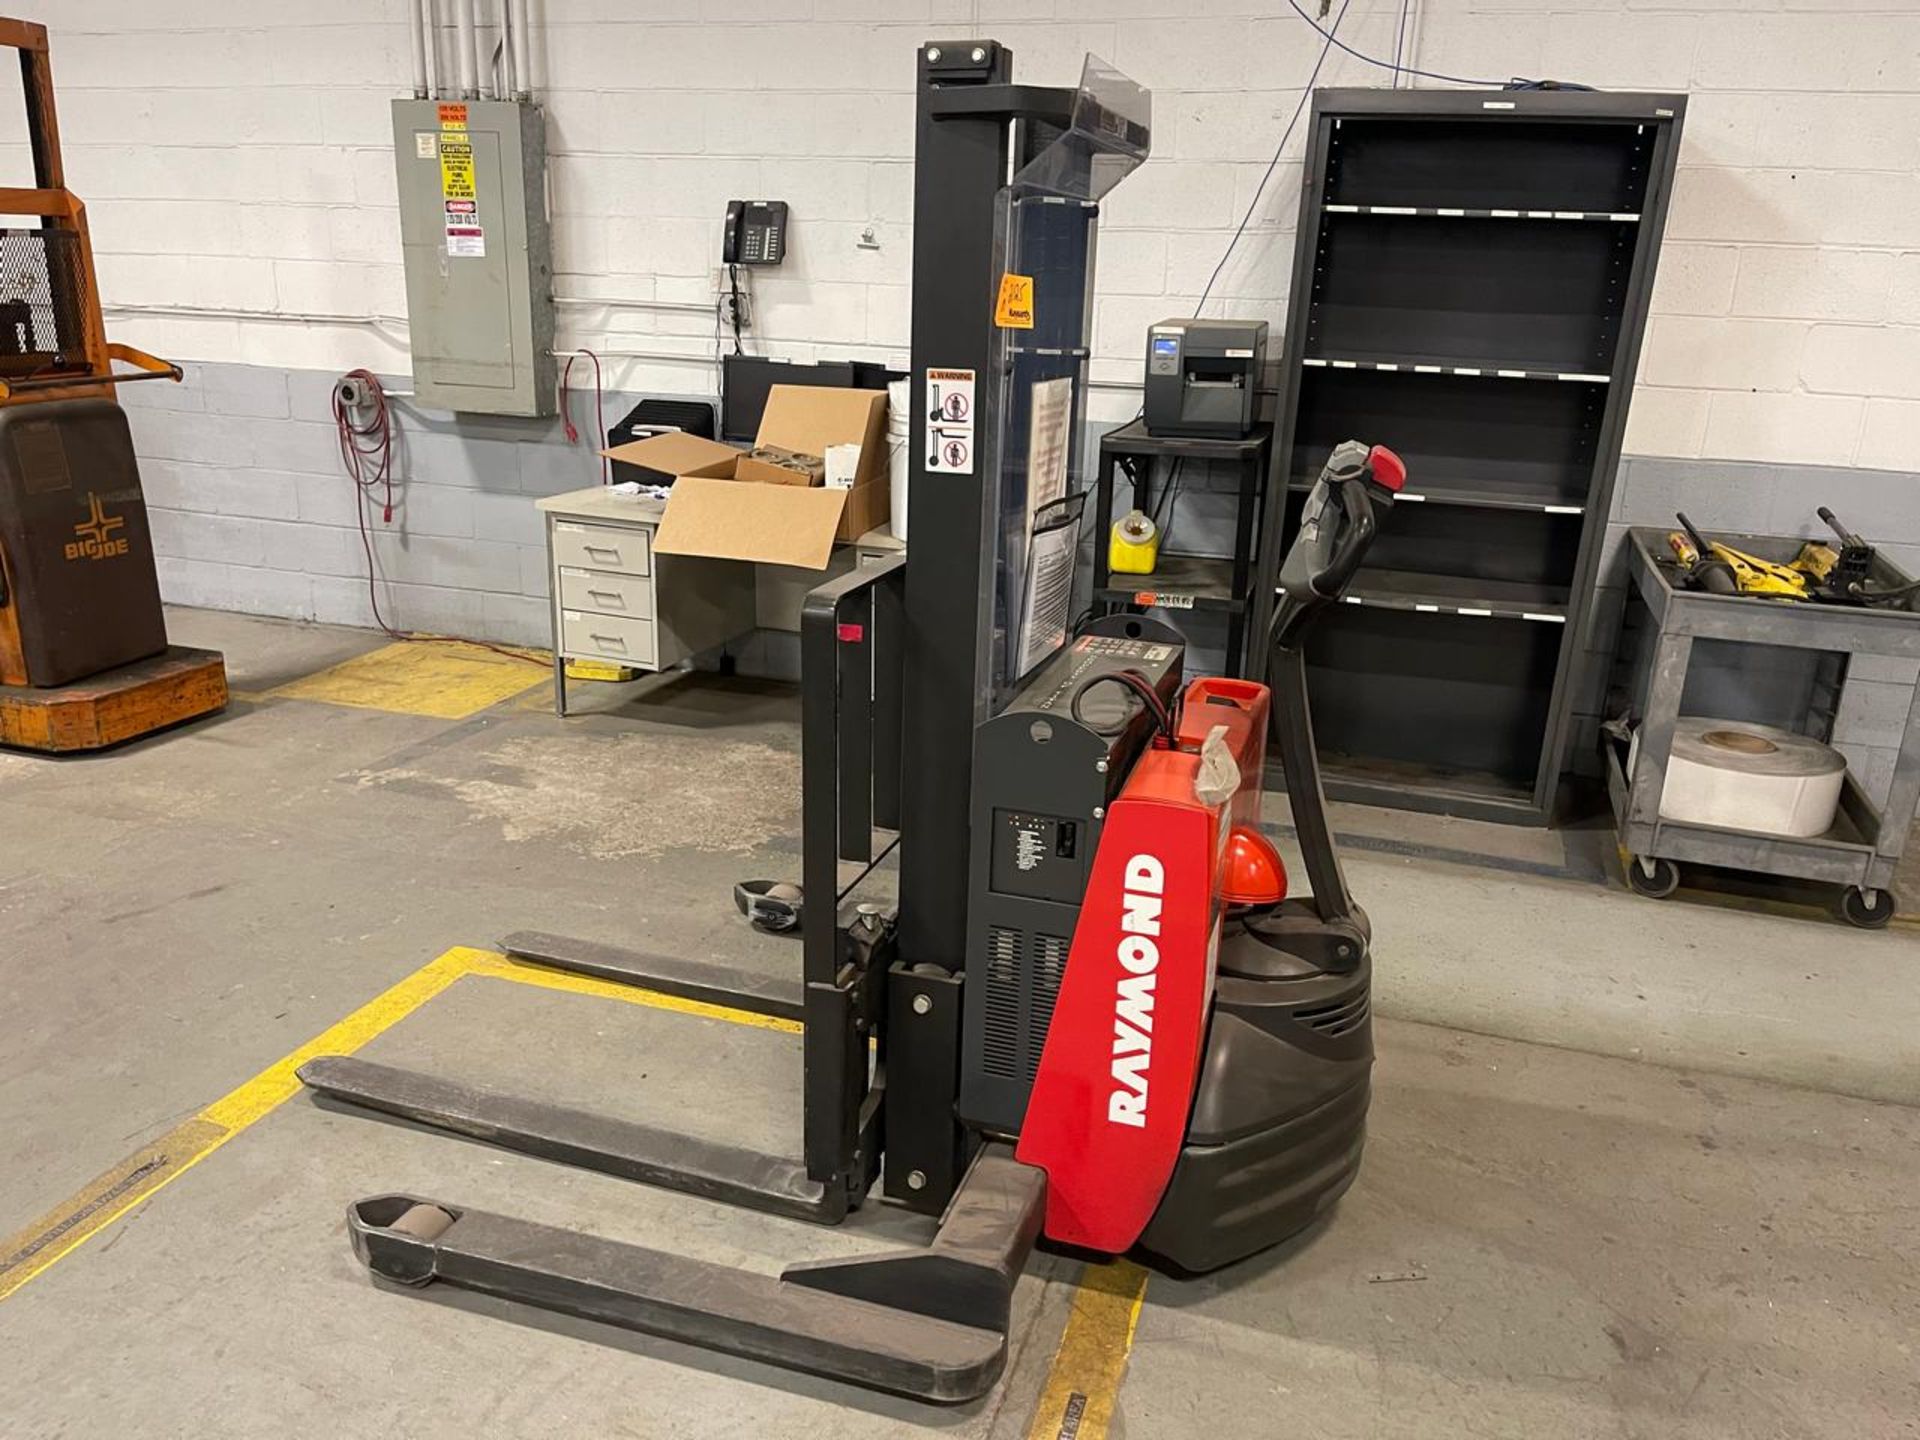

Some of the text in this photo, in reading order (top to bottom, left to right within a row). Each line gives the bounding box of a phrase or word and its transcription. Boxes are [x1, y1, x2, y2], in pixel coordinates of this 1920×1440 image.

[442, 144, 471, 153] CAUTION
[937, 371, 973, 381] WARNING
[1108, 853, 1165, 1129] RAYMOND
